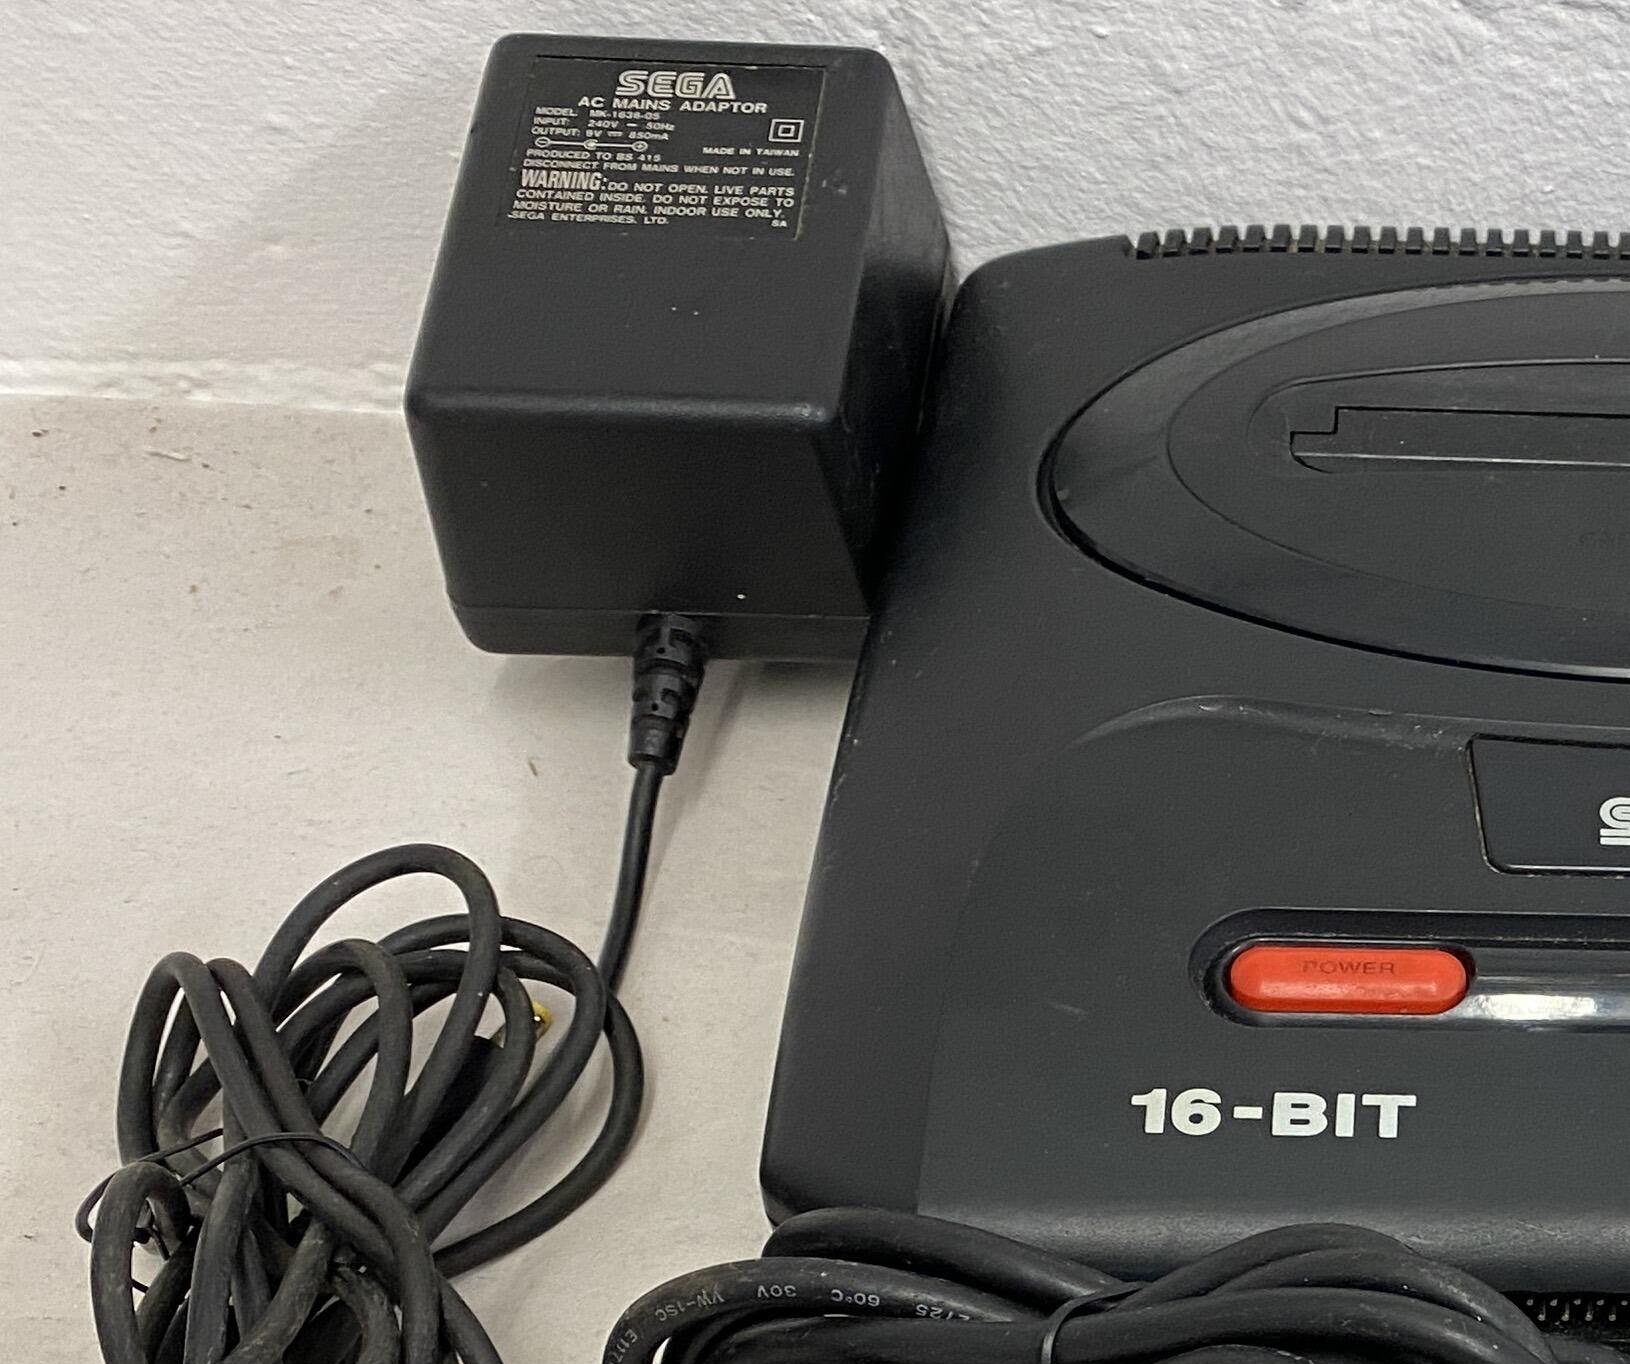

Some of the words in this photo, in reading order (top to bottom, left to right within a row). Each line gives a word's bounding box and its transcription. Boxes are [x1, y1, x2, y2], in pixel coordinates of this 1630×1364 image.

[615, 70, 736, 99] SEGA
[578, 96, 605, 108] AC
[612, 98, 671, 111] MAINS
[679, 101, 768, 113] ADAPTOR
[526, 148, 591, 159] PRODUCED
[595, 152, 612, 160] TO
[702, 147, 735, 155] MADE
[757, 149, 799, 157] TAIWAN
[523, 158, 599, 169] DISCONNECT
[603, 162, 637, 171] FROM
[641, 164, 679, 173] MAINS
[684, 165, 719, 174] WHEN
[723, 166, 748, 175] NOT
[752, 167, 765, 175] IN
[520, 169, 609, 191] WARNING:
[608, 182, 628, 191] DO
[634, 182, 664, 192] NOT
[714, 185, 744, 195] LIVE
[750, 187, 795, 196] PARTS
[516, 189, 594, 201] CONTAINED
[652, 194, 673, 203] DO
[679, 195, 708, 205] NOT
[713, 196, 768, 206] EXPOSE
[776, 198, 794, 207] TO
[512, 200, 583, 211] MOISTURE
[588, 203, 608, 212] OR
[653, 205, 707, 216] INDOOR
[711, 207, 739, 217] USE
[1302, 961, 1395, 975] POWER
[1131, 1087, 1416, 1138] 16-BIT
[757, 1284, 797, 1299] 30V
[831, 1289, 880, 1307] 60°C
